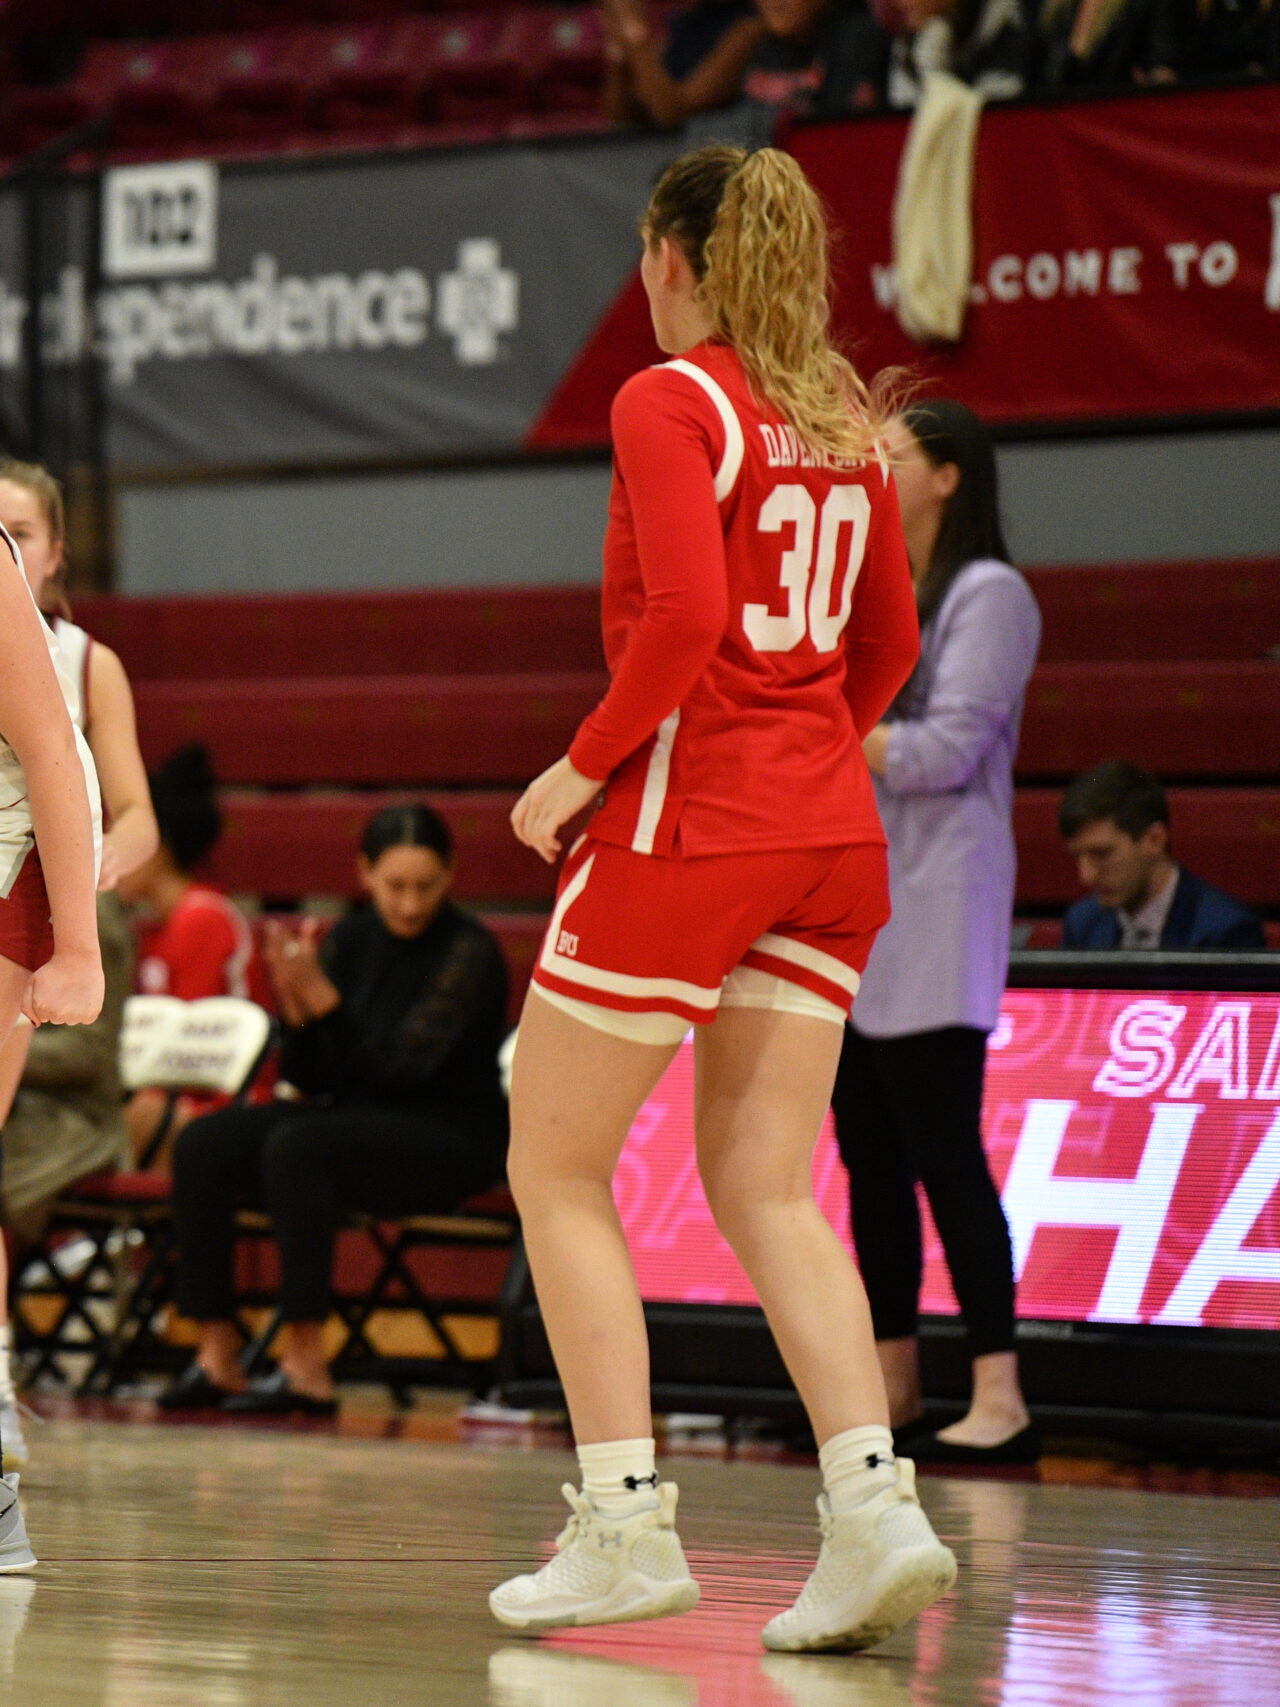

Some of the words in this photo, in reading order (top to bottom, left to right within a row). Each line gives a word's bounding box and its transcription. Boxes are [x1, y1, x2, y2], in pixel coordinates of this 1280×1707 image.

[871, 246, 1142, 310] COME
[1166, 240, 1239, 288] TO
[742, 484, 871, 652] 30
[1000, 1098, 1280, 1327] HA
